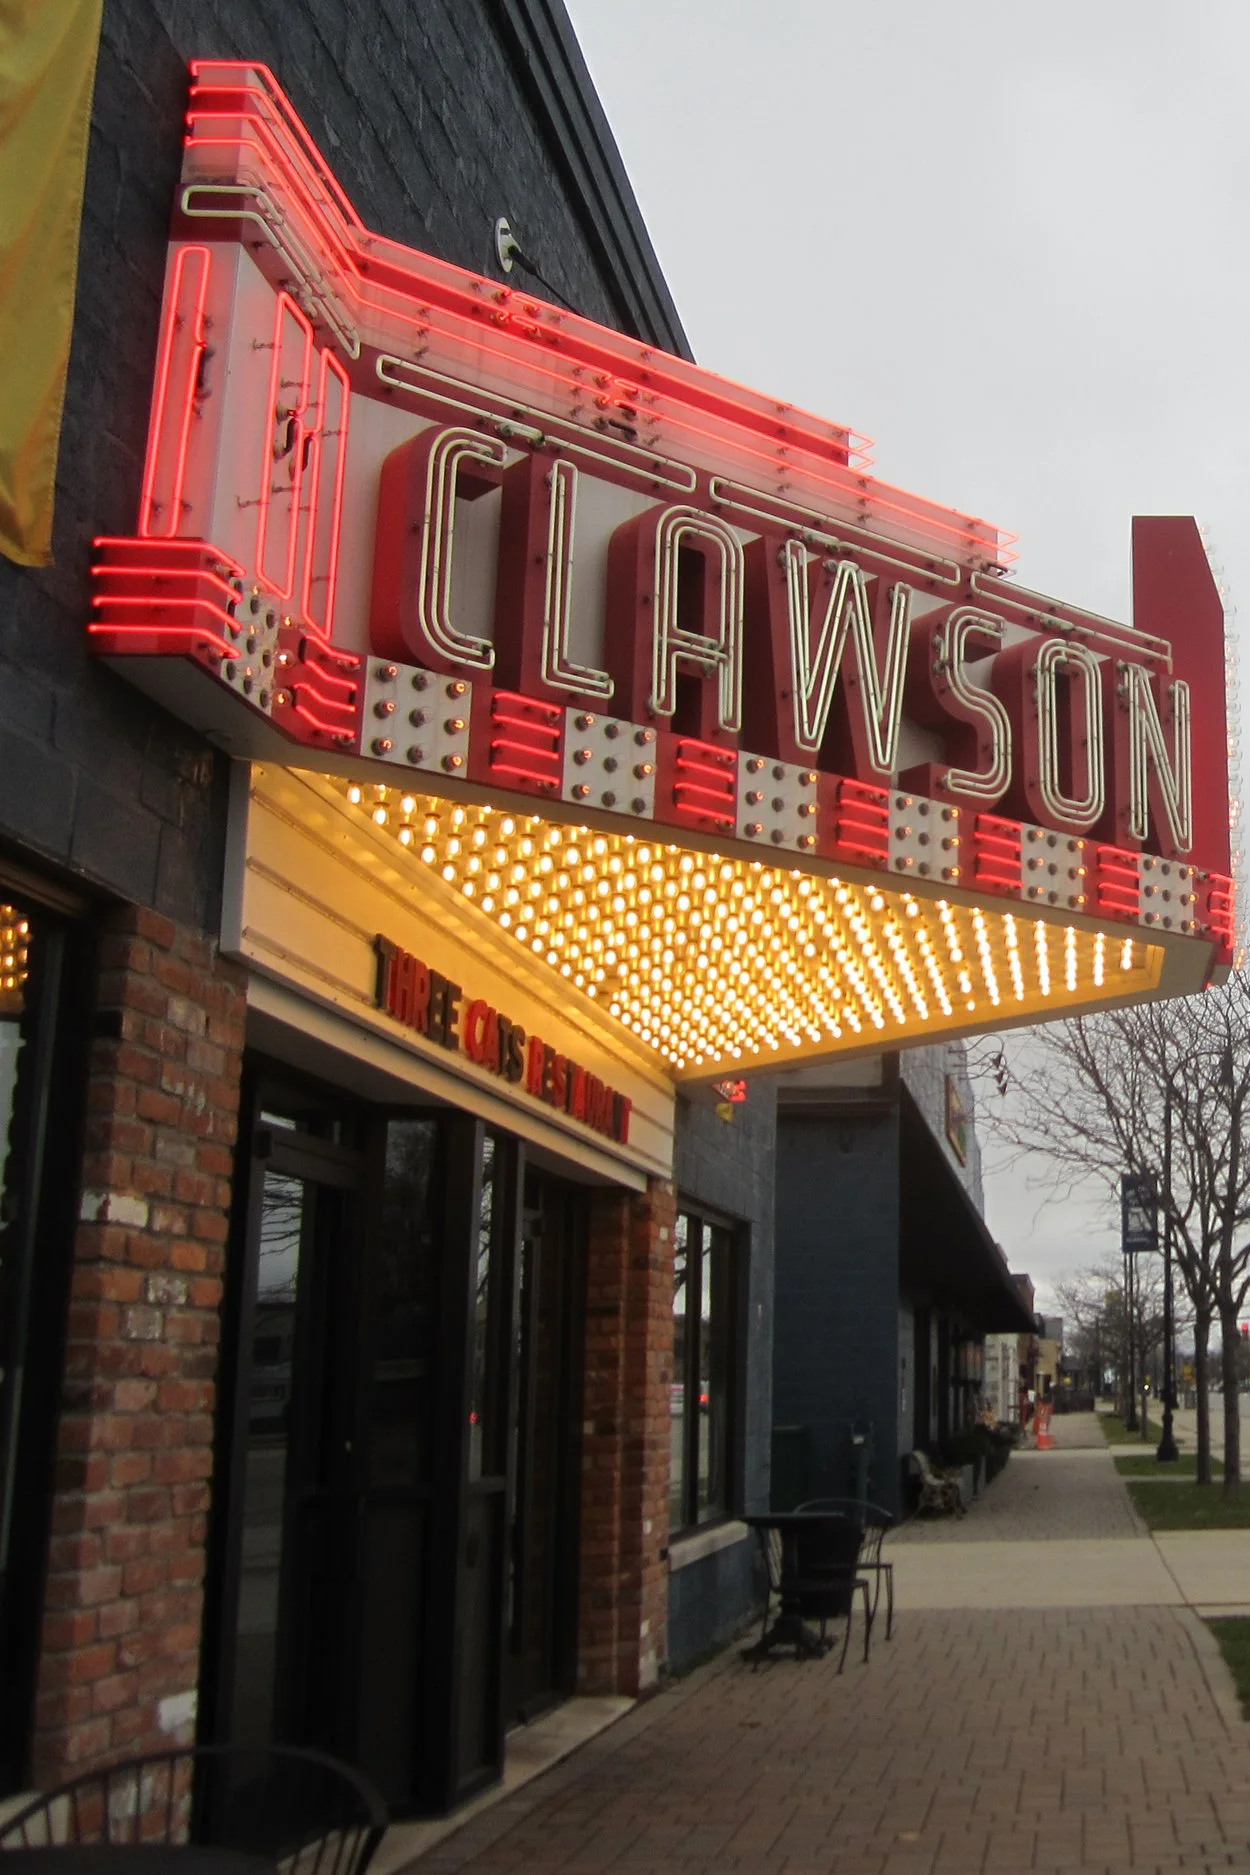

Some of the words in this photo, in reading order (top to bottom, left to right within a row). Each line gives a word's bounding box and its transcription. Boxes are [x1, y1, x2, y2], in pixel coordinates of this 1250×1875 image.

[385, 423, 1193, 855] CLAWSON
[373, 933, 462, 1050] THREE
[464, 999, 526, 1084] CATS
